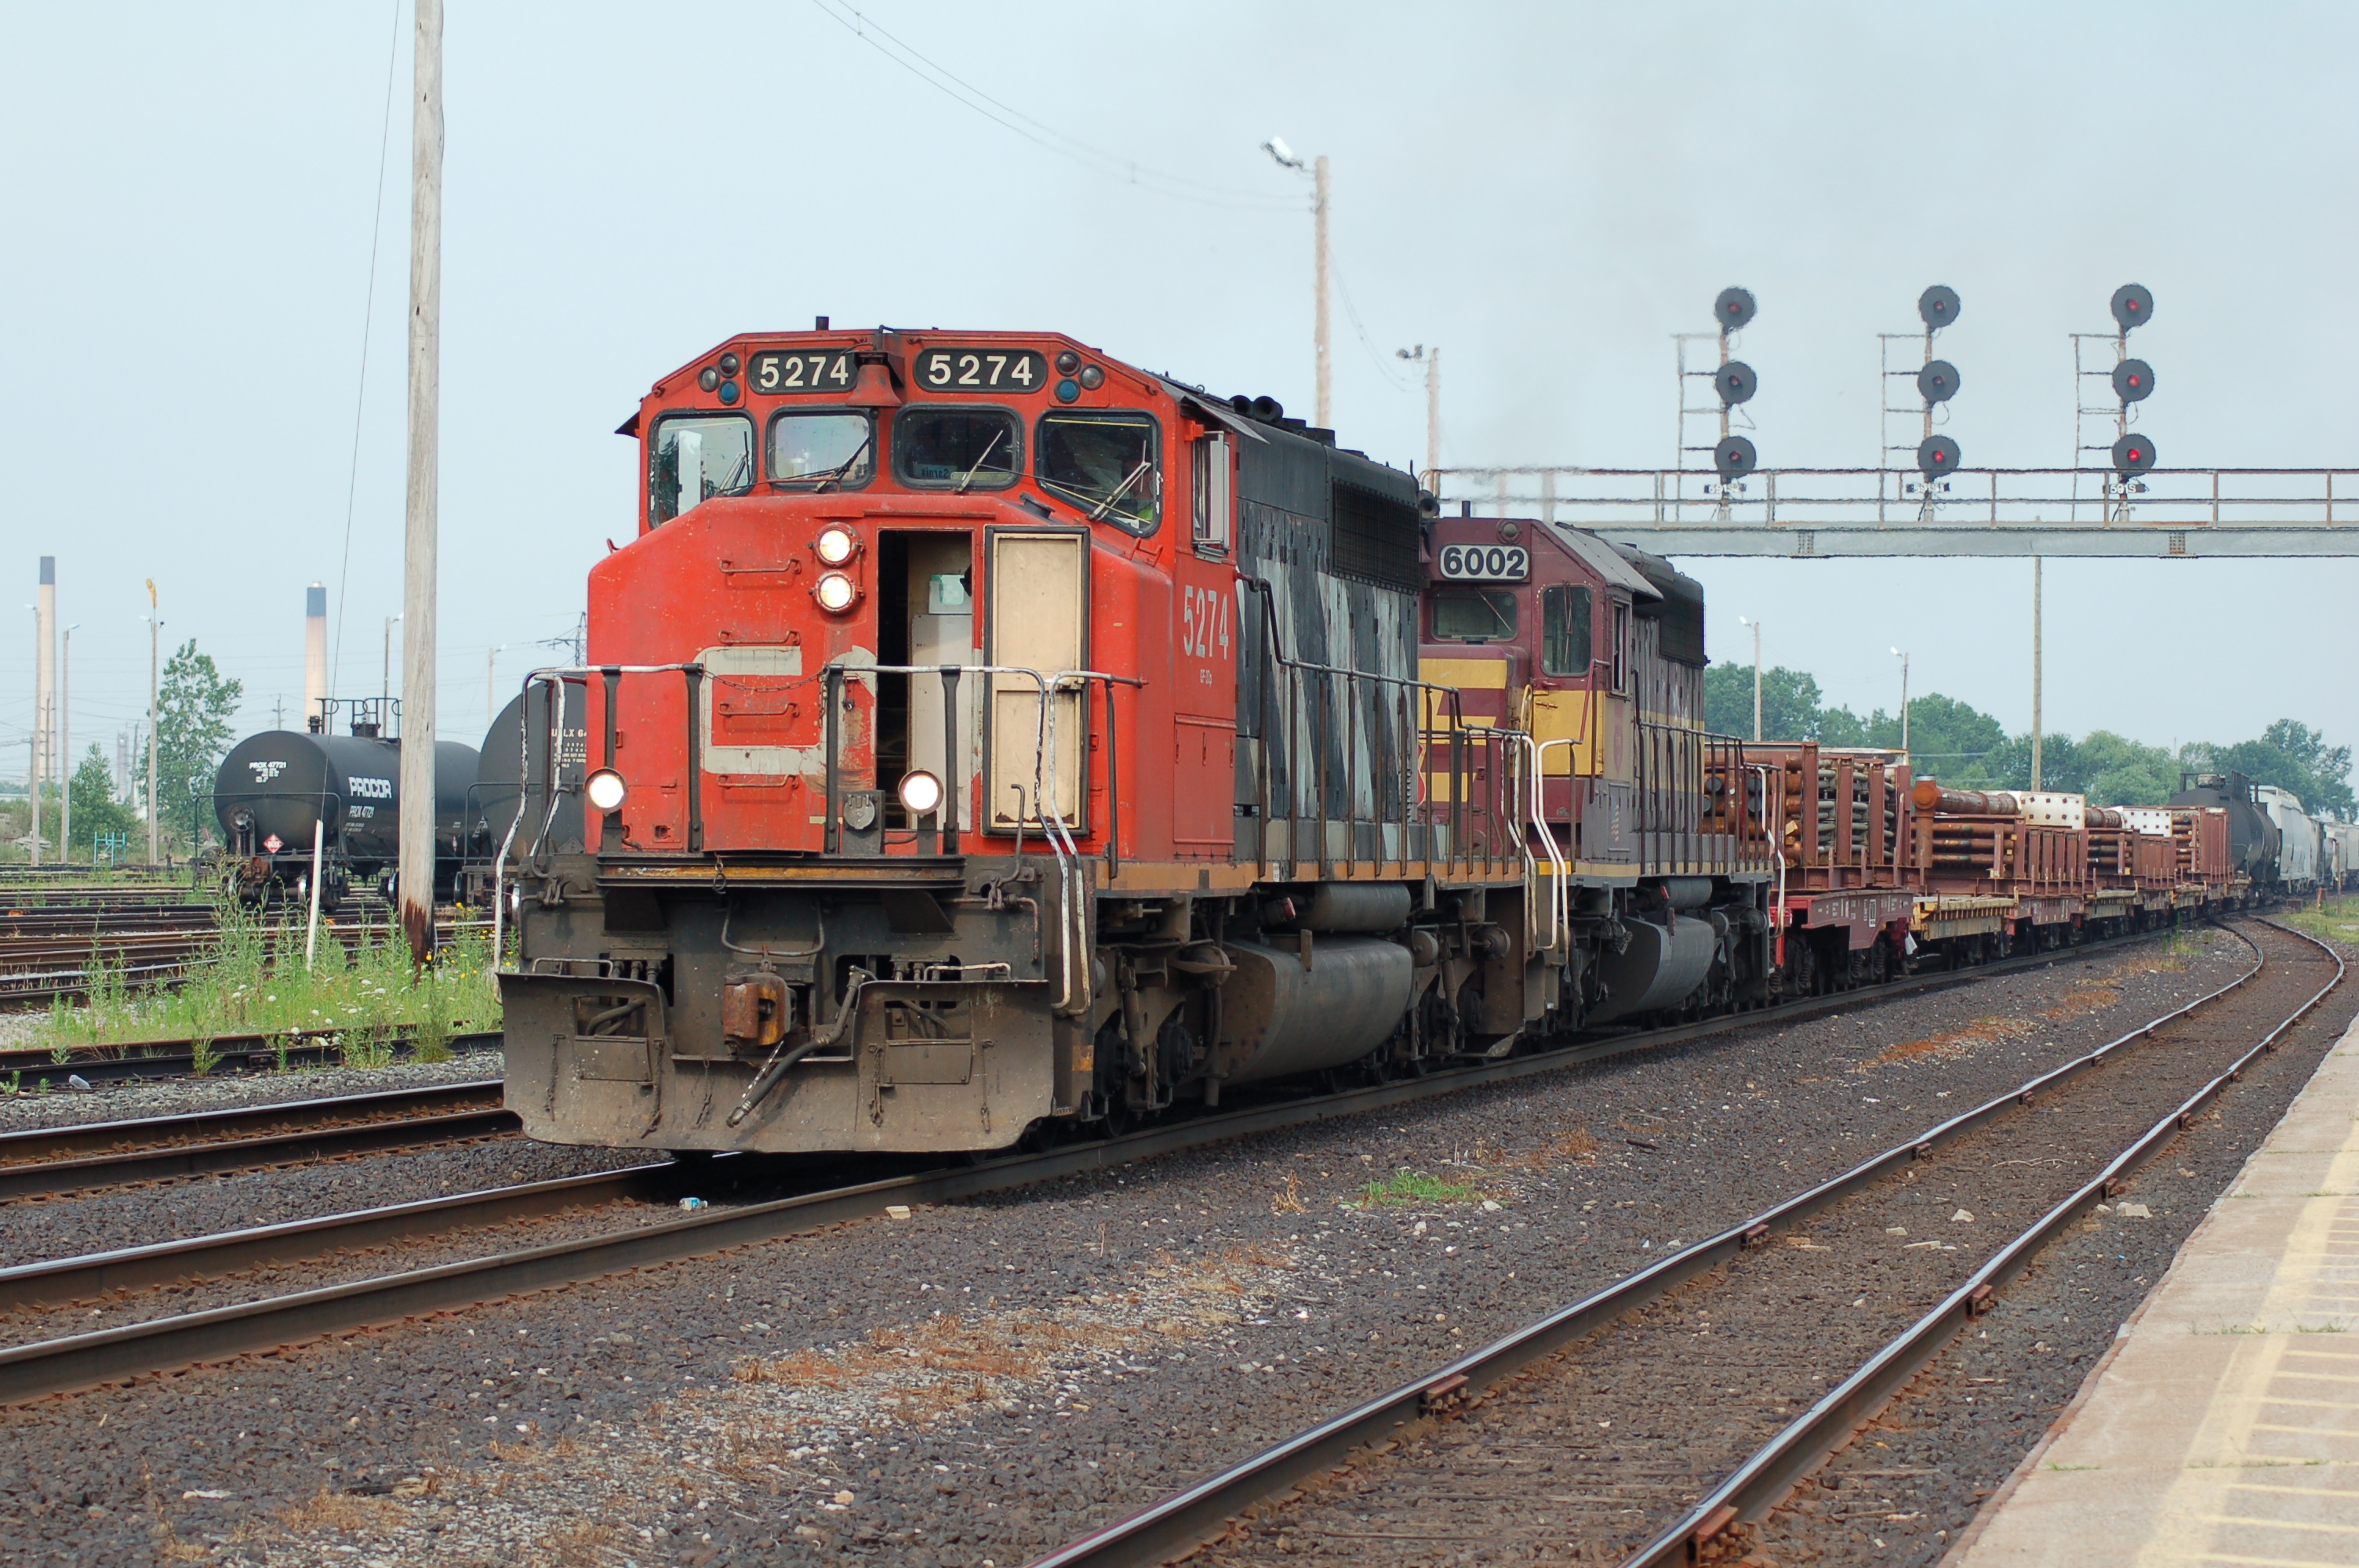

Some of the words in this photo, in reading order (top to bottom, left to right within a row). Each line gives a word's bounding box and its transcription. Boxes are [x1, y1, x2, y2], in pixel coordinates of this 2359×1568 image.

[759, 357, 849, 388] 5274
[929, 354, 1034, 386] 5274
[1444, 547, 1525, 576] 6002
[1183, 584, 1229, 660] 5274
[551, 728, 575, 737] ULX
[348, 776, 392, 799] PROCOR
[348, 805, 363, 818] PROX
